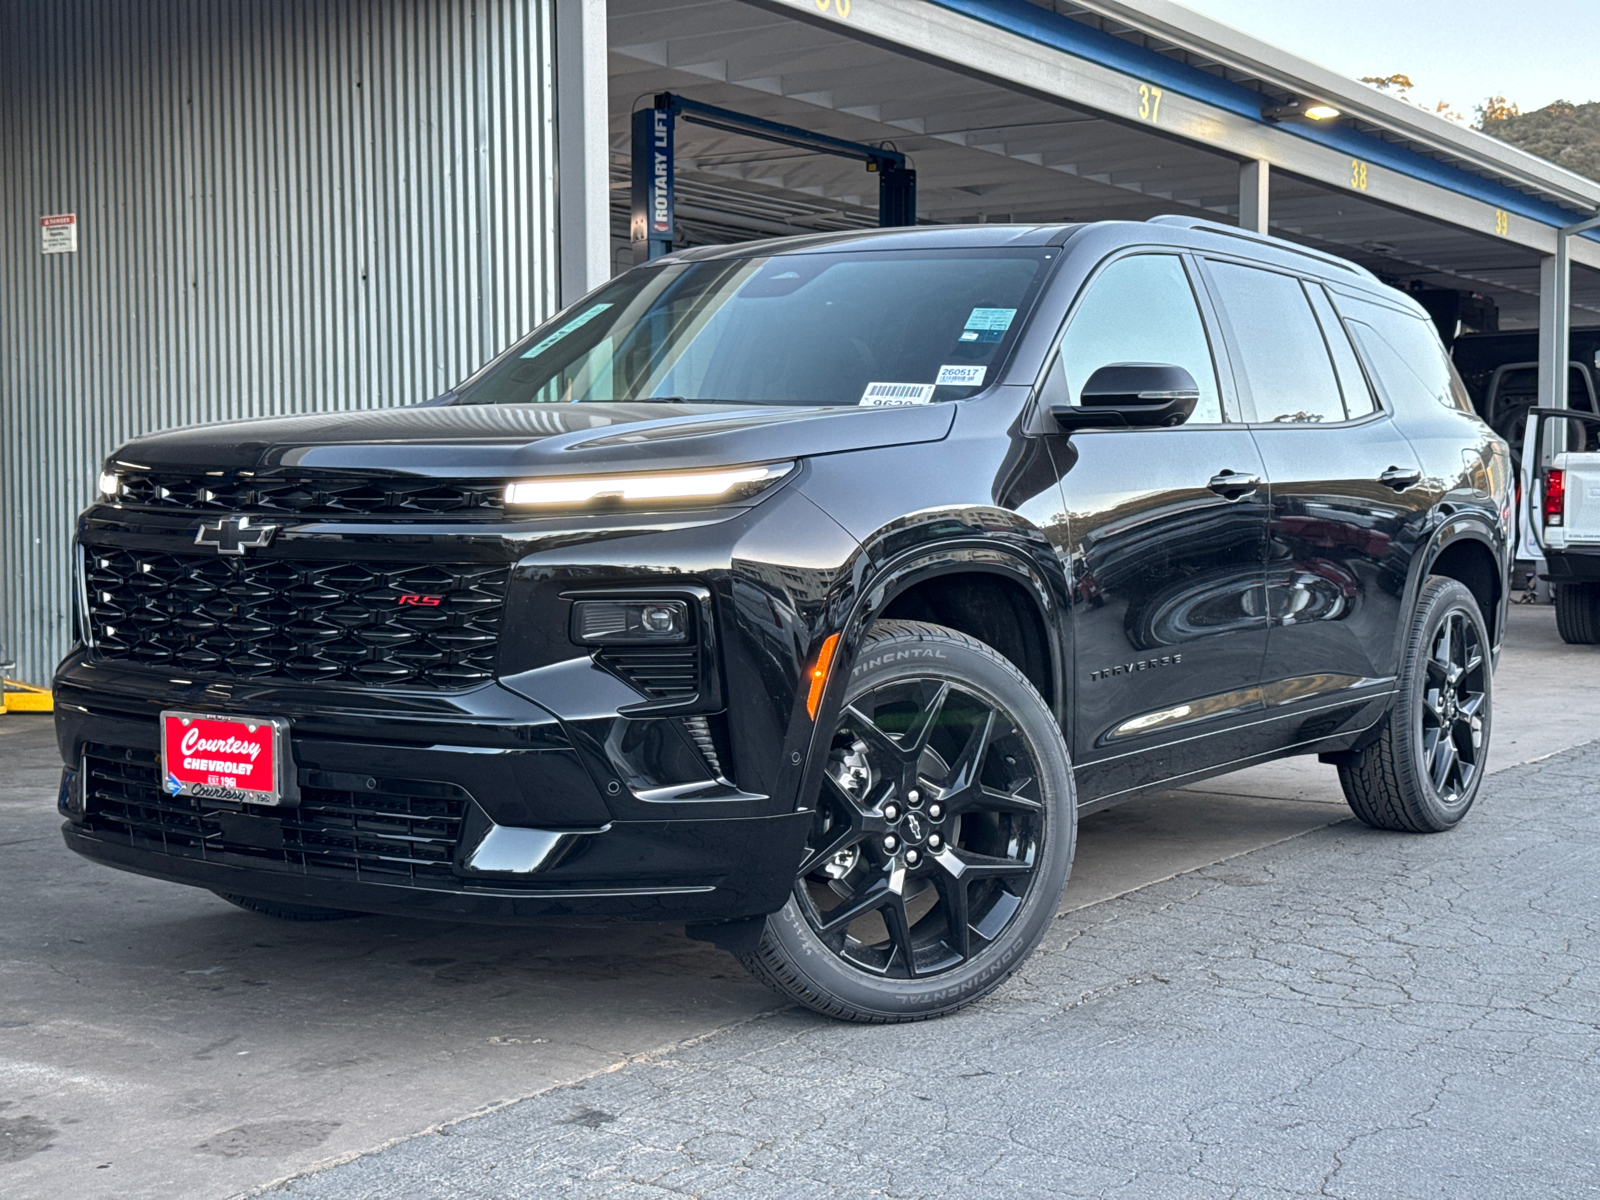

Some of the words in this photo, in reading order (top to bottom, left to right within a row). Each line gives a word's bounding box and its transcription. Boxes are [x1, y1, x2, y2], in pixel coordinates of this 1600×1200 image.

[1138, 84, 1162, 123] 37
[654, 110, 668, 147] LIFT
[654, 152, 668, 222] ROTARY
[1351, 160, 1367, 191] 38
[50, 217, 71, 225] DANGER
[1495, 210, 1508, 236] 39
[941, 368, 979, 376] 260517
[398, 595, 441, 606] RS
[1090, 654, 1181, 682] TRAVERSE
[181, 727, 261, 762] Courtesy
[183, 757, 253, 776] CHEVROLET
[191, 782, 246, 804] Courtesy
[895, 936, 1025, 1005] CONTINENTAL
